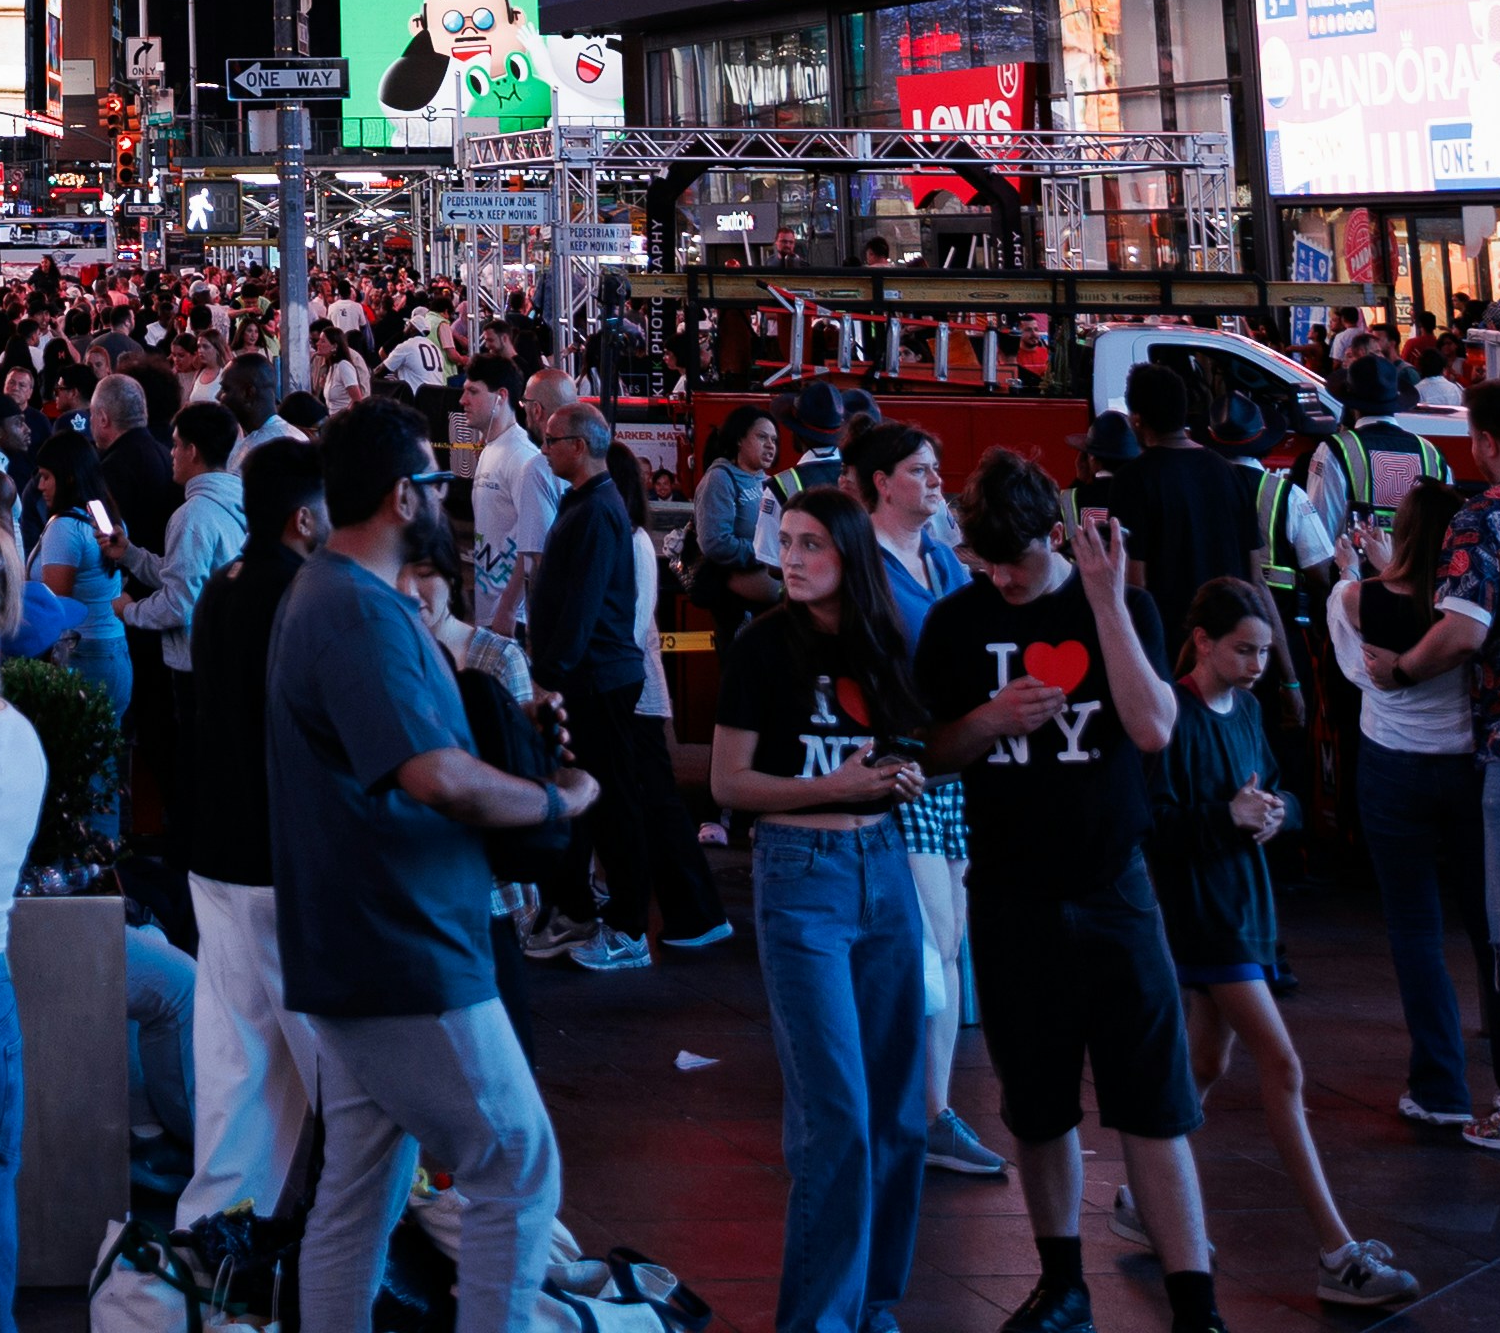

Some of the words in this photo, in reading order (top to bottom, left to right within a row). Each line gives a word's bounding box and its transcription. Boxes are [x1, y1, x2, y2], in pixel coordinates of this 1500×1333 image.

[132, 67, 155, 76] ONLY
[1301, 44, 1475, 109] PANDORA
[246, 71, 280, 87] ONE
[296, 71, 333, 87] WAY
[1441, 148, 1476, 175] ONE
[447, 196, 492, 206] PEDESTRIAN
[495, 197, 514, 206] FLOW
[517, 197, 537, 207] ZONE
[487, 210, 507, 219] KEEP
[509, 210, 538, 220] MOVING
[570, 228, 614, 238] PEDESTRIAN
[570, 241, 589, 251] KEEP
[590, 241, 618, 252] MOVING
[986, 643, 1017, 699] I
